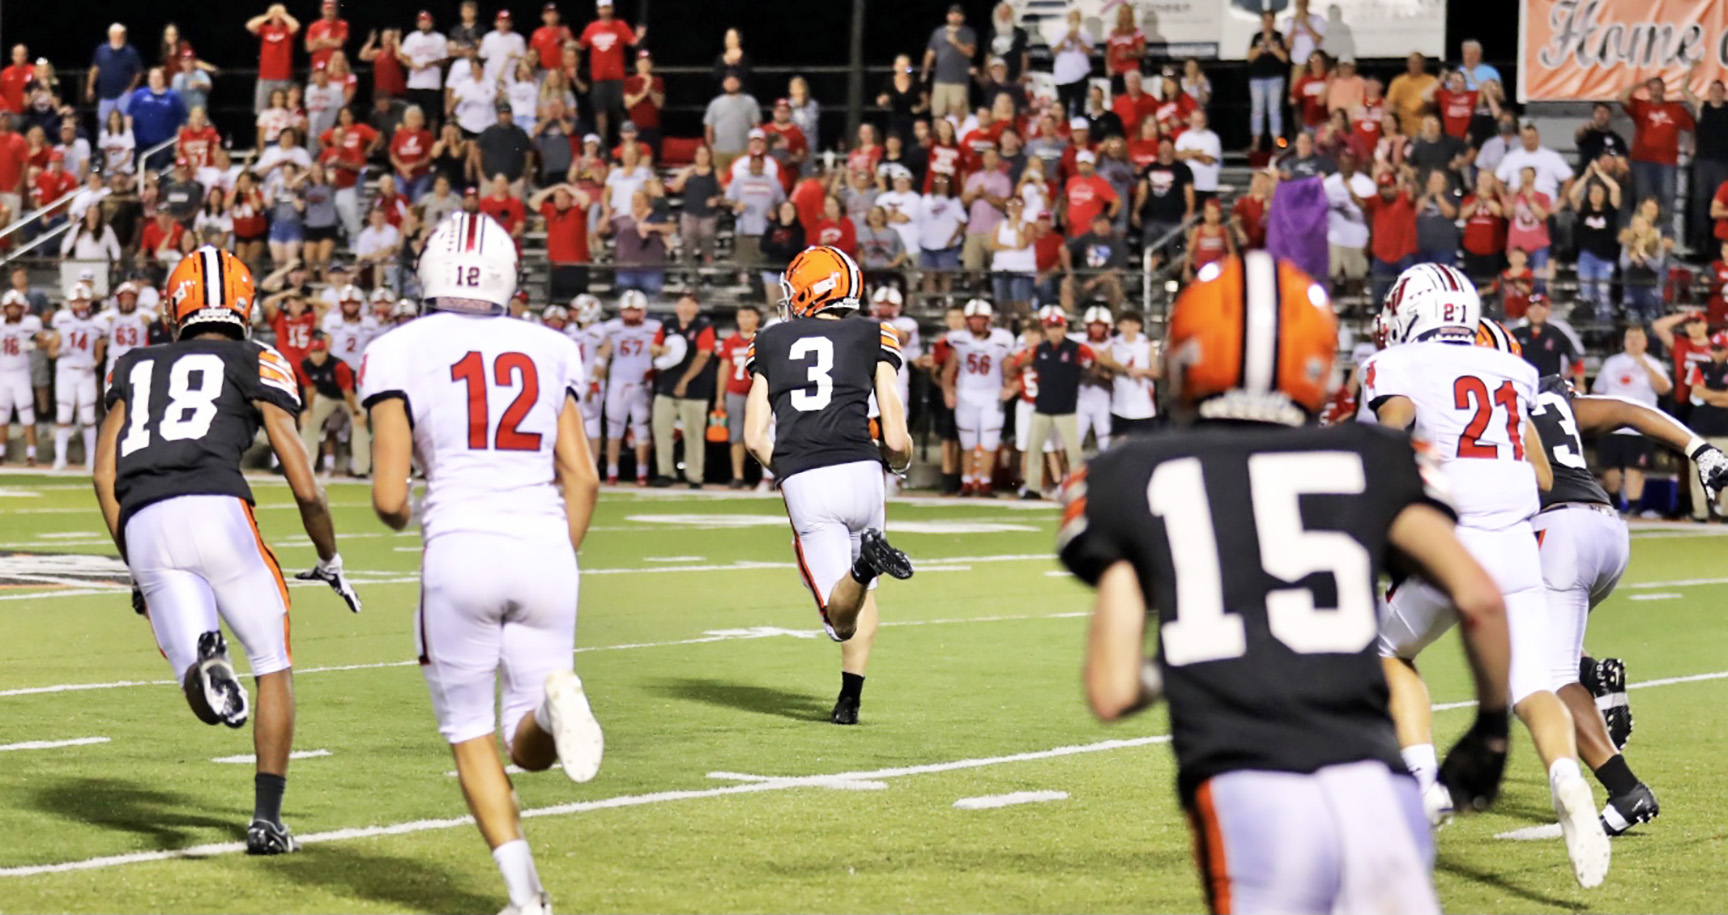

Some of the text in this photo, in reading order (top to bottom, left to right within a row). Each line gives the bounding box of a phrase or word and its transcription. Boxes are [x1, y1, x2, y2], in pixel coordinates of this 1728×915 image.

[1538, 0, 1706, 69] Home
[456, 265, 480, 287] 12
[1443, 303, 1467, 323] 21
[69, 331, 88, 351] 14
[115, 327, 138, 346] 63
[346, 337, 356, 353] 2
[621, 340, 644, 357] 57
[788, 336, 834, 412] 3
[966, 353, 991, 376] 56
[121, 354, 226, 458] 18
[450, 350, 543, 452] 12
[1453, 375, 1526, 462] 21
[1147, 450, 1379, 667] 15
